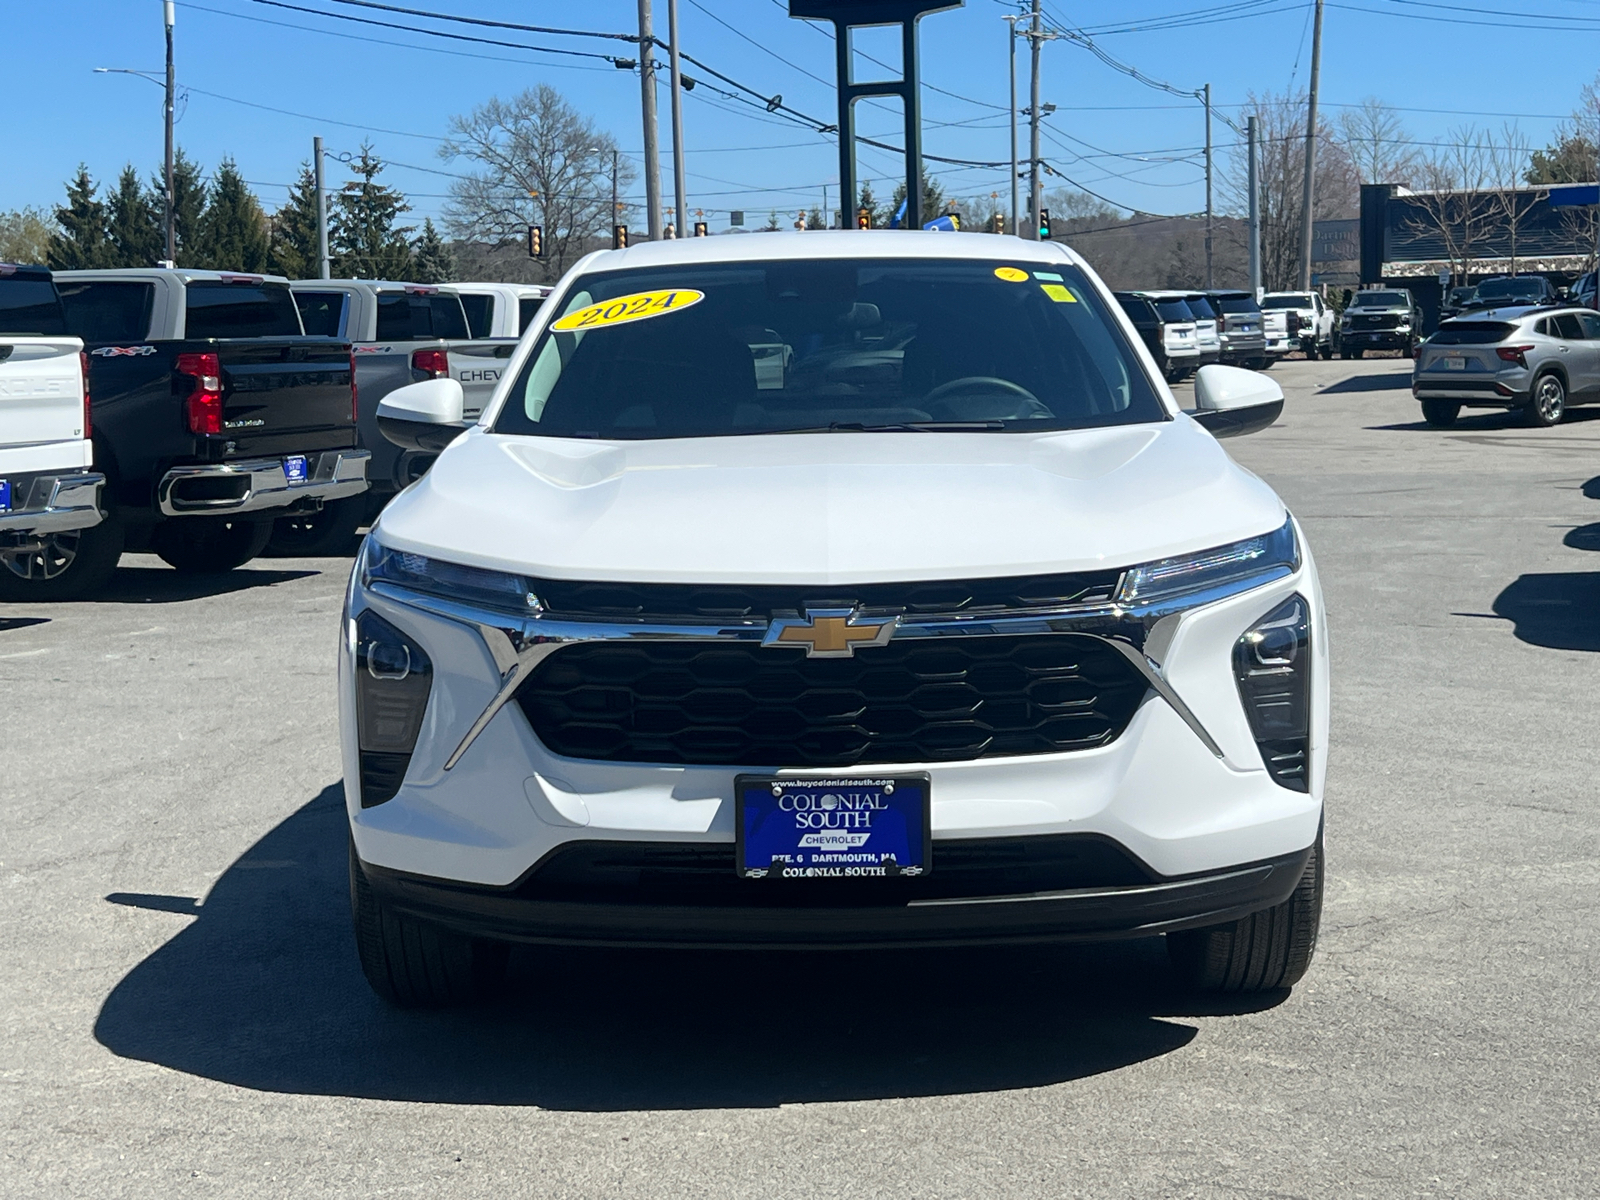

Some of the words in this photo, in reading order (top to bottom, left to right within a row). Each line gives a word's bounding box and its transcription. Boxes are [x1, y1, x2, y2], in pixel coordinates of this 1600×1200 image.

[576, 292, 678, 327] 2024
[771, 779, 895, 788] www.buycolonialsouth.com
[778, 793, 889, 812] COLONIAL
[795, 811, 872, 829] SOUTH
[805, 836, 862, 845] CHEVROLET
[796, 854, 804, 863] 6
[811, 853, 879, 864] DARTMOUTH,
[782, 868, 843, 878] COLONIAL
[844, 867, 887, 877] SOUTH
